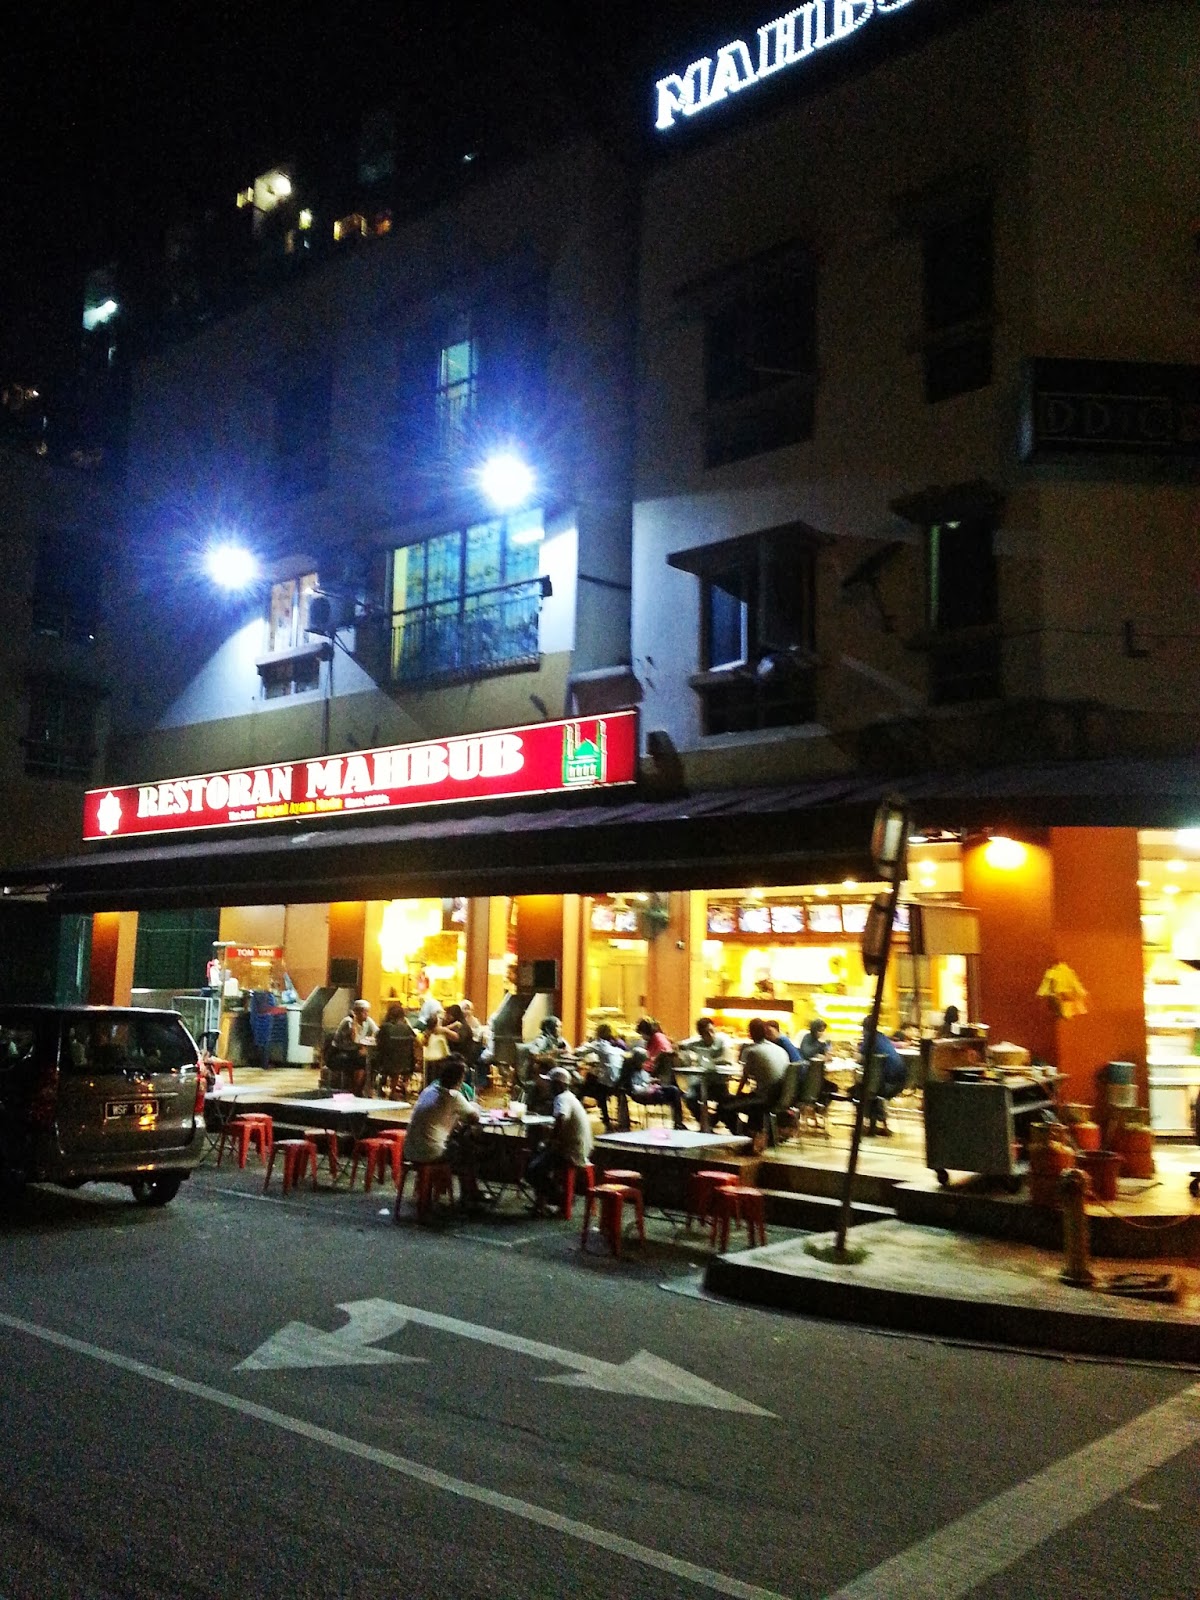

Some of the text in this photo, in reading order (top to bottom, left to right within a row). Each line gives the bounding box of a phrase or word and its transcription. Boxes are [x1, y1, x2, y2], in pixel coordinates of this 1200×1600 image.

[655, 0, 912, 130] MAHB
[136, 734, 525, 818] RESTORAN MAHBUB
[237, 948, 275, 957] TOM YAM
